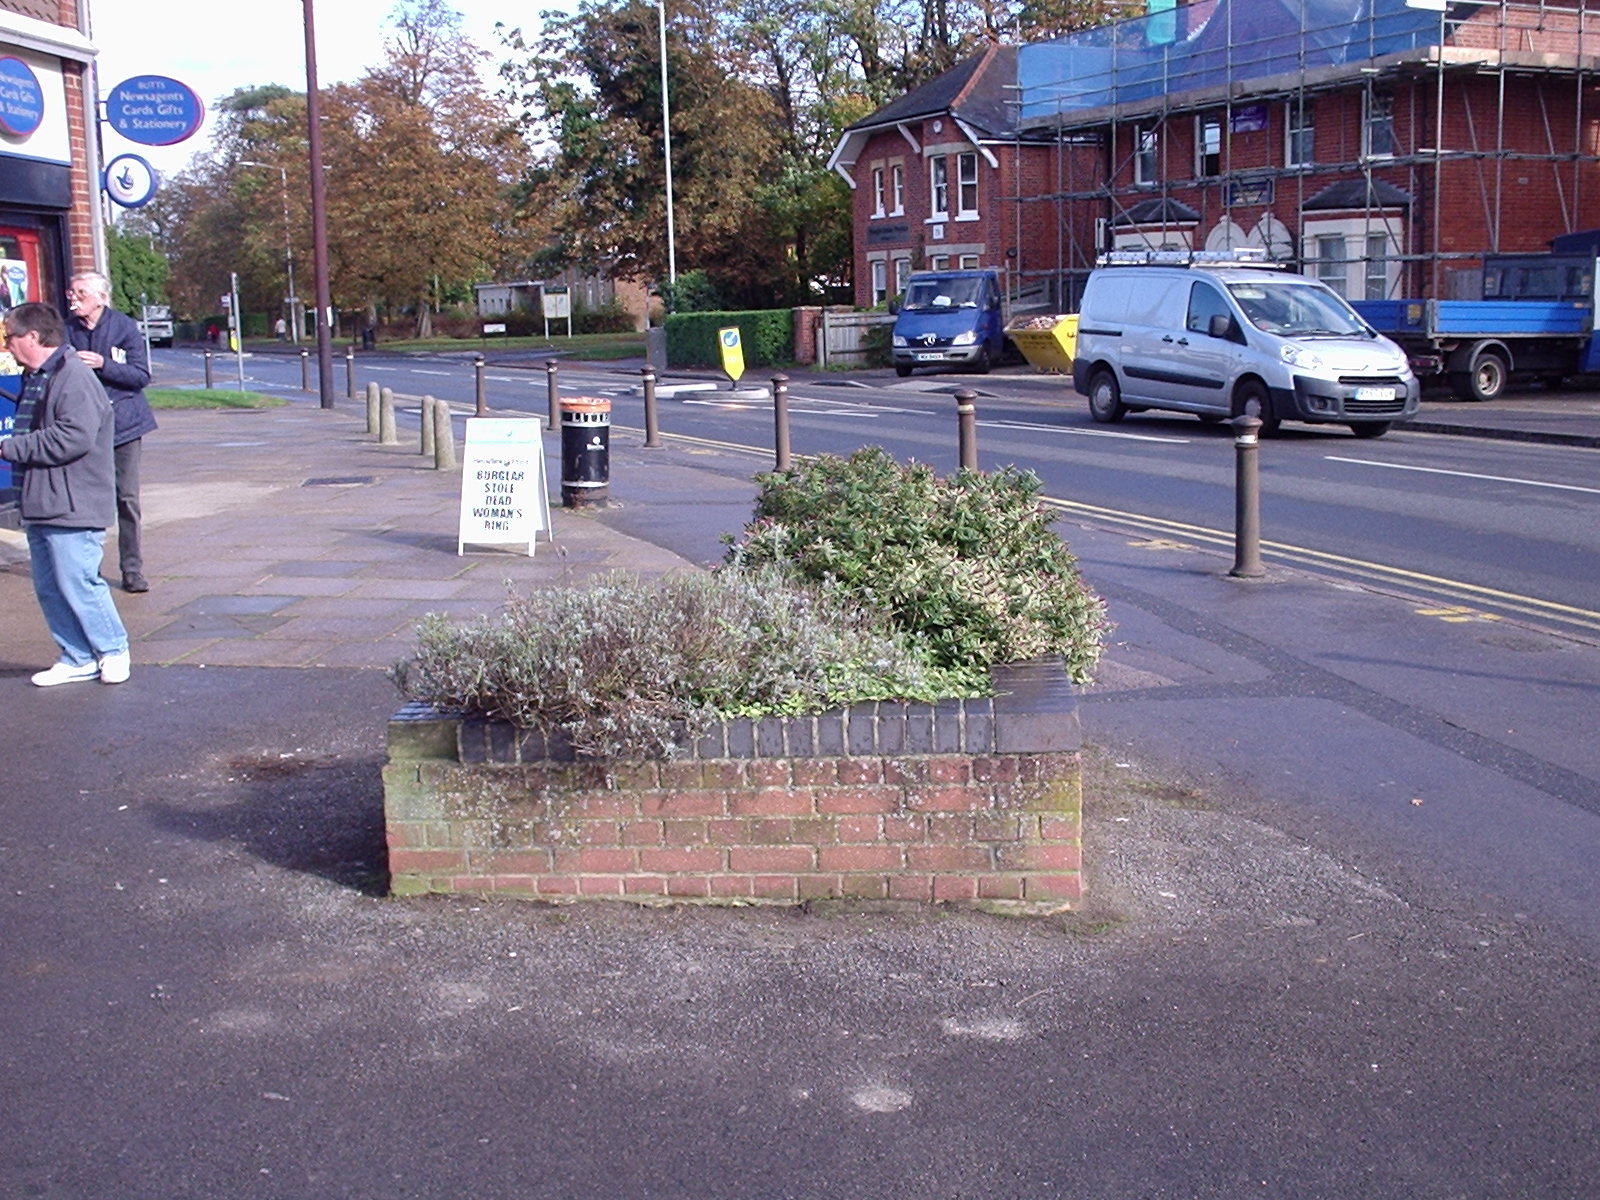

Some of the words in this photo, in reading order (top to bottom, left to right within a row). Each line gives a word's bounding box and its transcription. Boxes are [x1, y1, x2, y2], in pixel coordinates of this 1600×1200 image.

[120, 91, 184, 104] Newsagents
[122, 104, 153, 115] Cards
[157, 104, 184, 115] Gifts
[119, 118, 128, 129] &
[133, 118, 187, 131] Stationery
[476, 470, 525, 481] BURGLAR
[484, 482, 514, 494] STOLE
[485, 495, 512, 506] DEAD
[484, 520, 509, 531] RING
